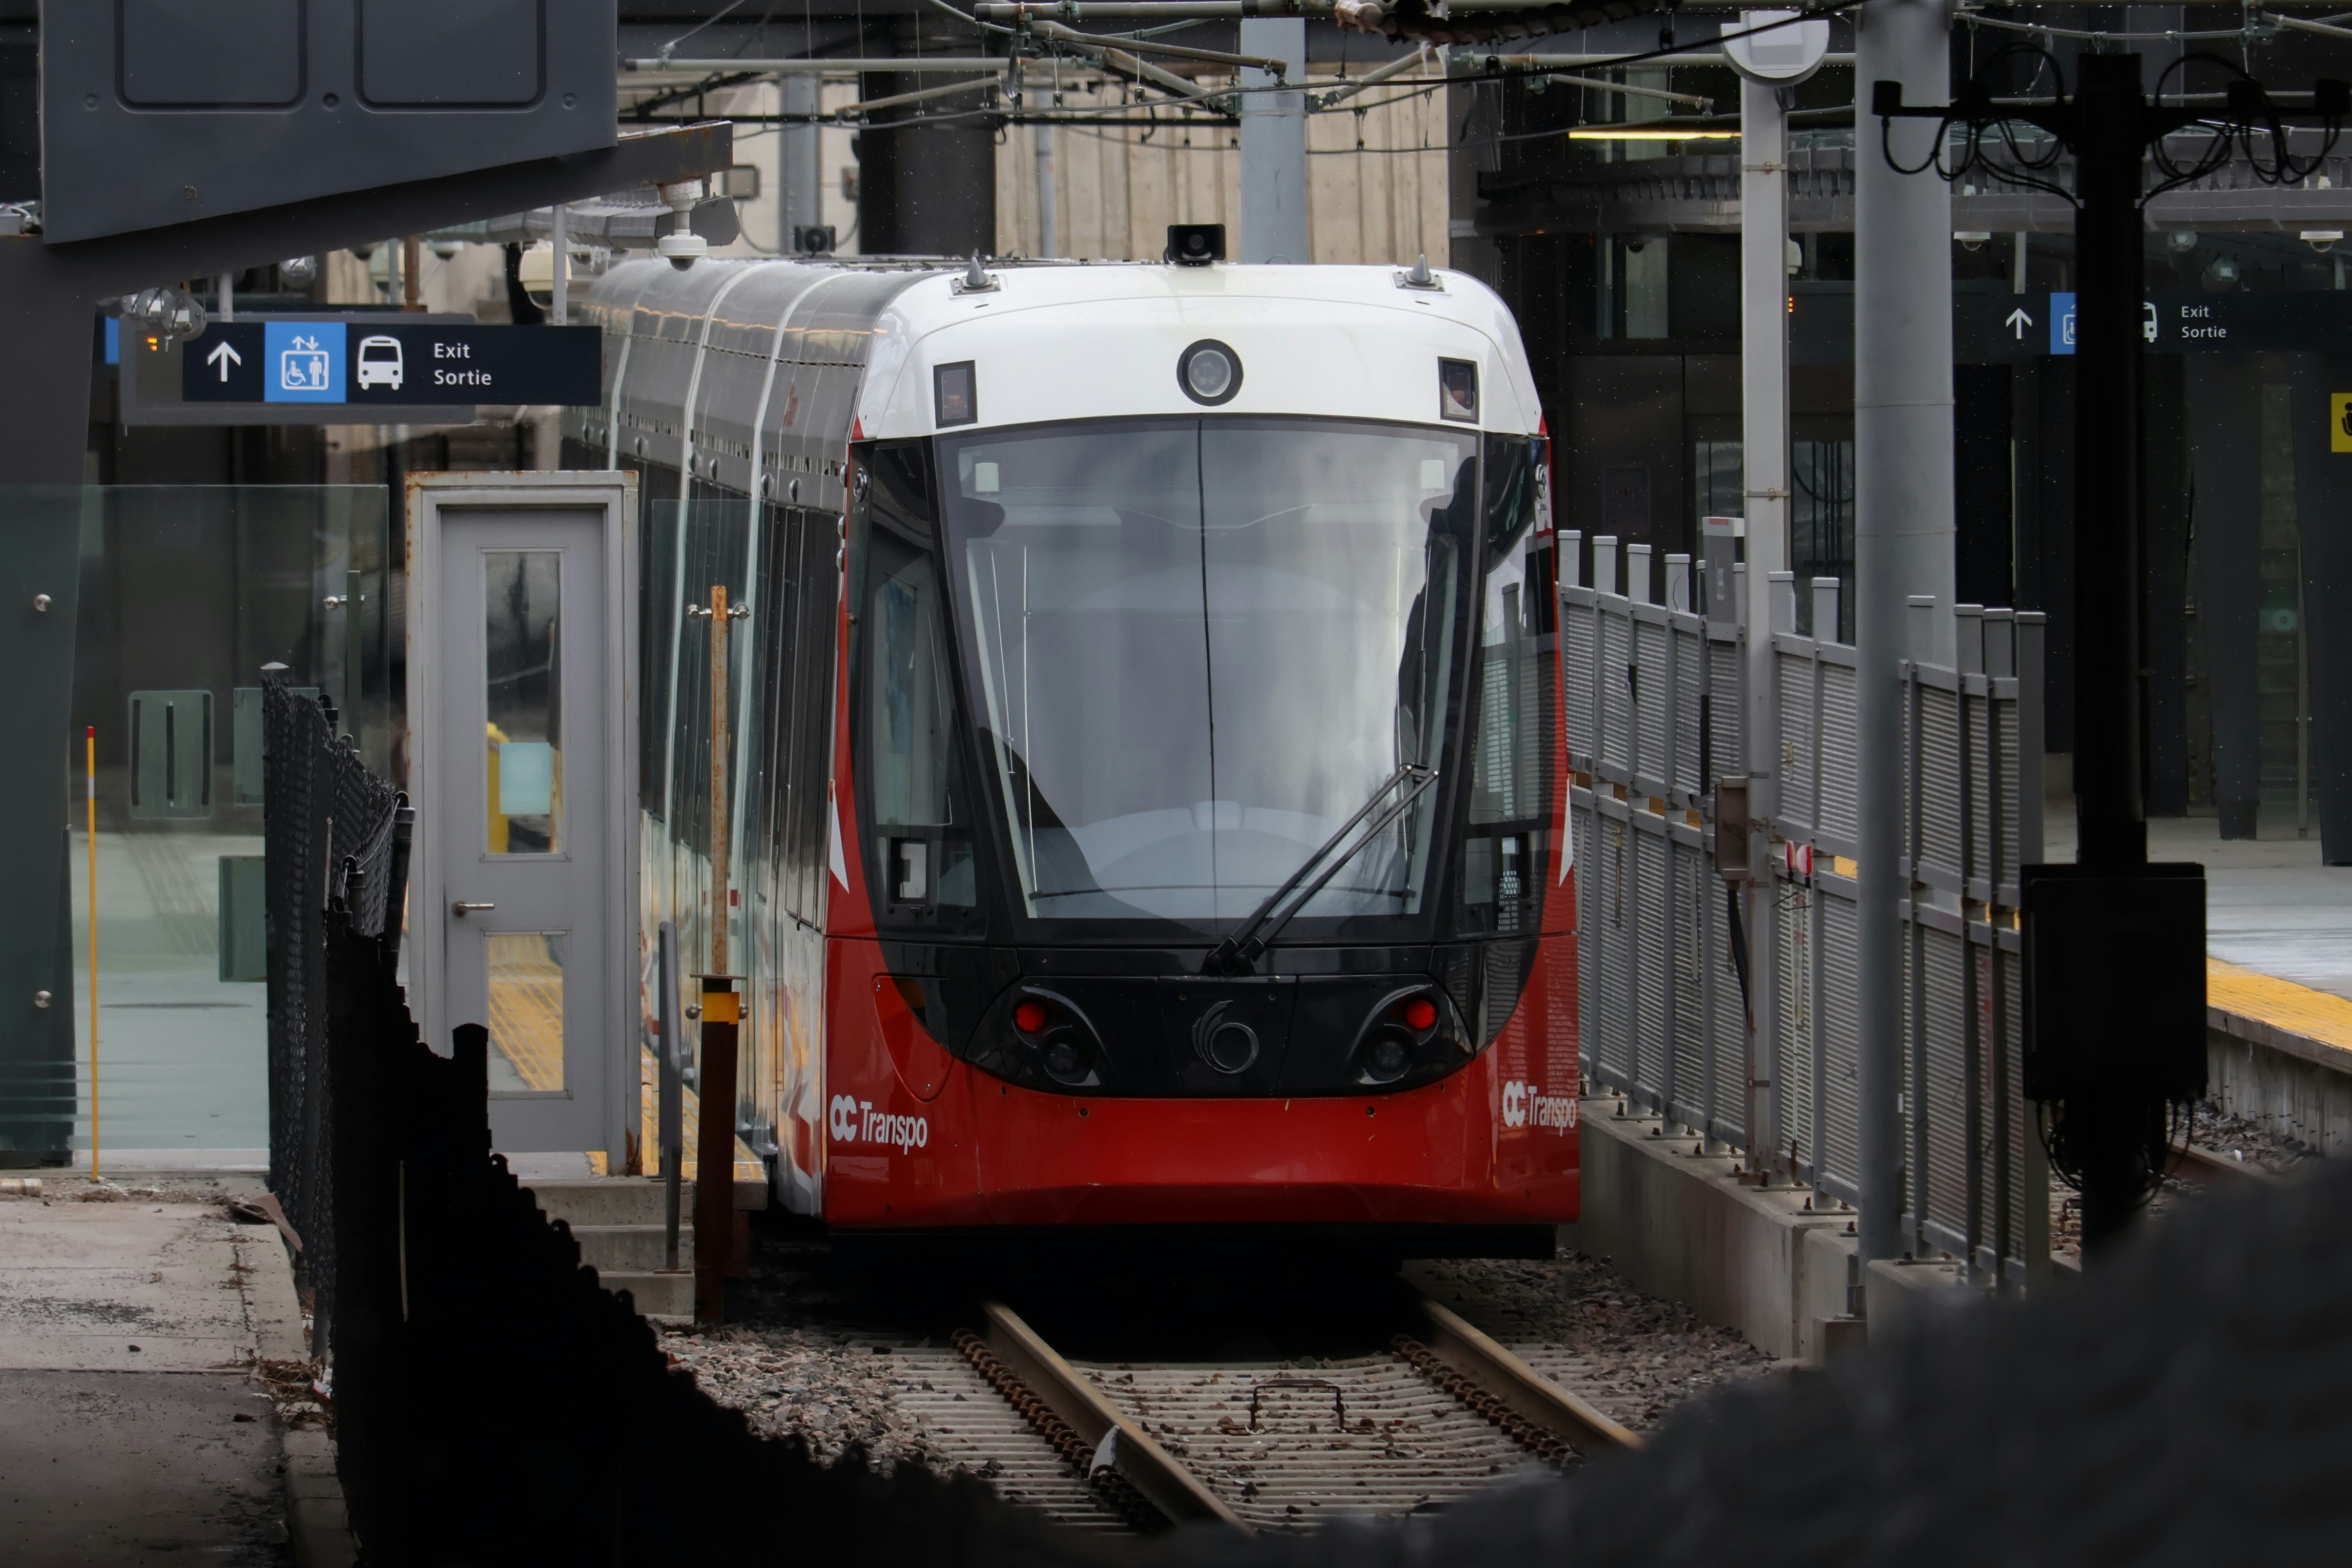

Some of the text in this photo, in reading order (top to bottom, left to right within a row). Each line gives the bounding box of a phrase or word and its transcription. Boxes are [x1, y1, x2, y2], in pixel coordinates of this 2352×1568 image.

[2181, 305, 2210, 317] Exit
[2181, 325, 2226, 338] Sortie
[434, 342, 470, 358] Exit
[434, 369, 492, 385] Sortie
[1502, 1081, 1576, 1137] OC Transpo
[830, 1095, 927, 1155] OC Transpo
